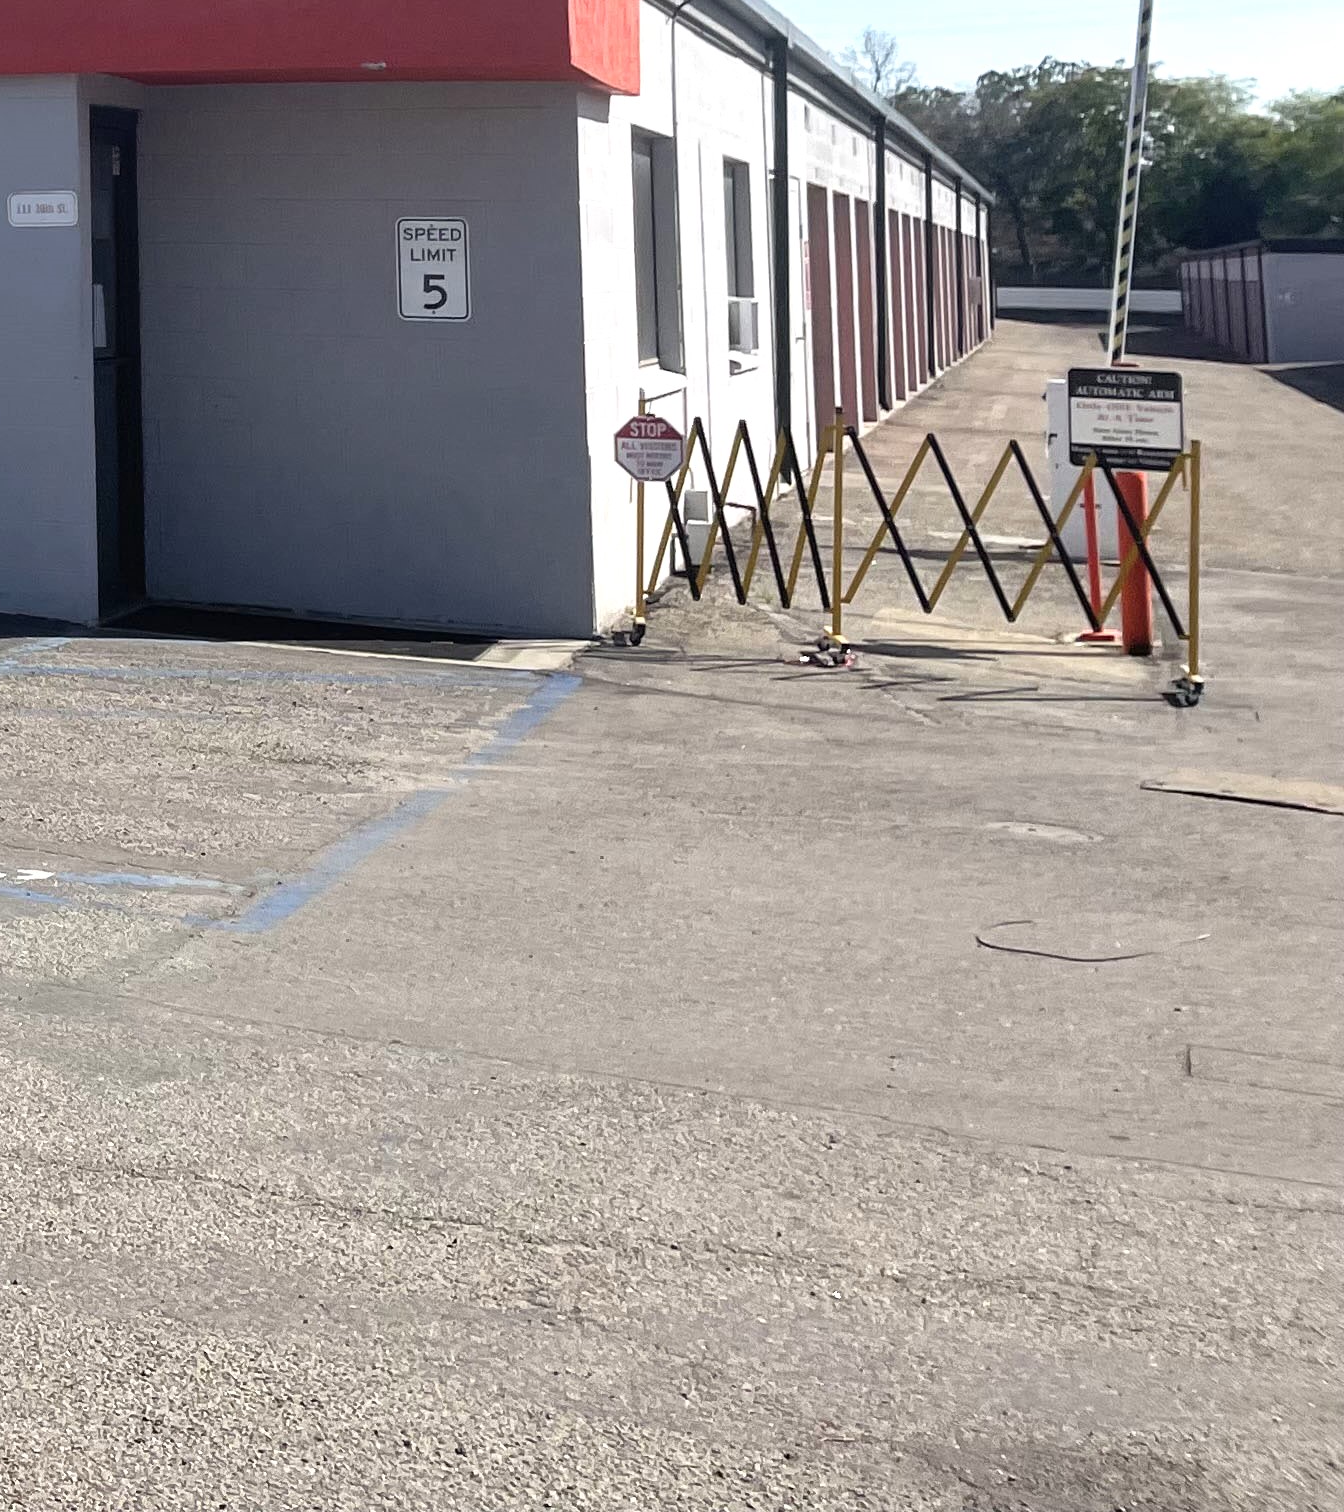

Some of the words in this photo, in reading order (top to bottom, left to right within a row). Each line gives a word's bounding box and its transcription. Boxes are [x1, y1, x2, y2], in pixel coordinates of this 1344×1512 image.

[403, 228, 461, 241] SPEED
[410, 248, 457, 262] LIMIT
[423, 274, 448, 310] 5
[1076, 386, 1144, 398] AUTOMATIC
[630, 422, 667, 437] STOP
